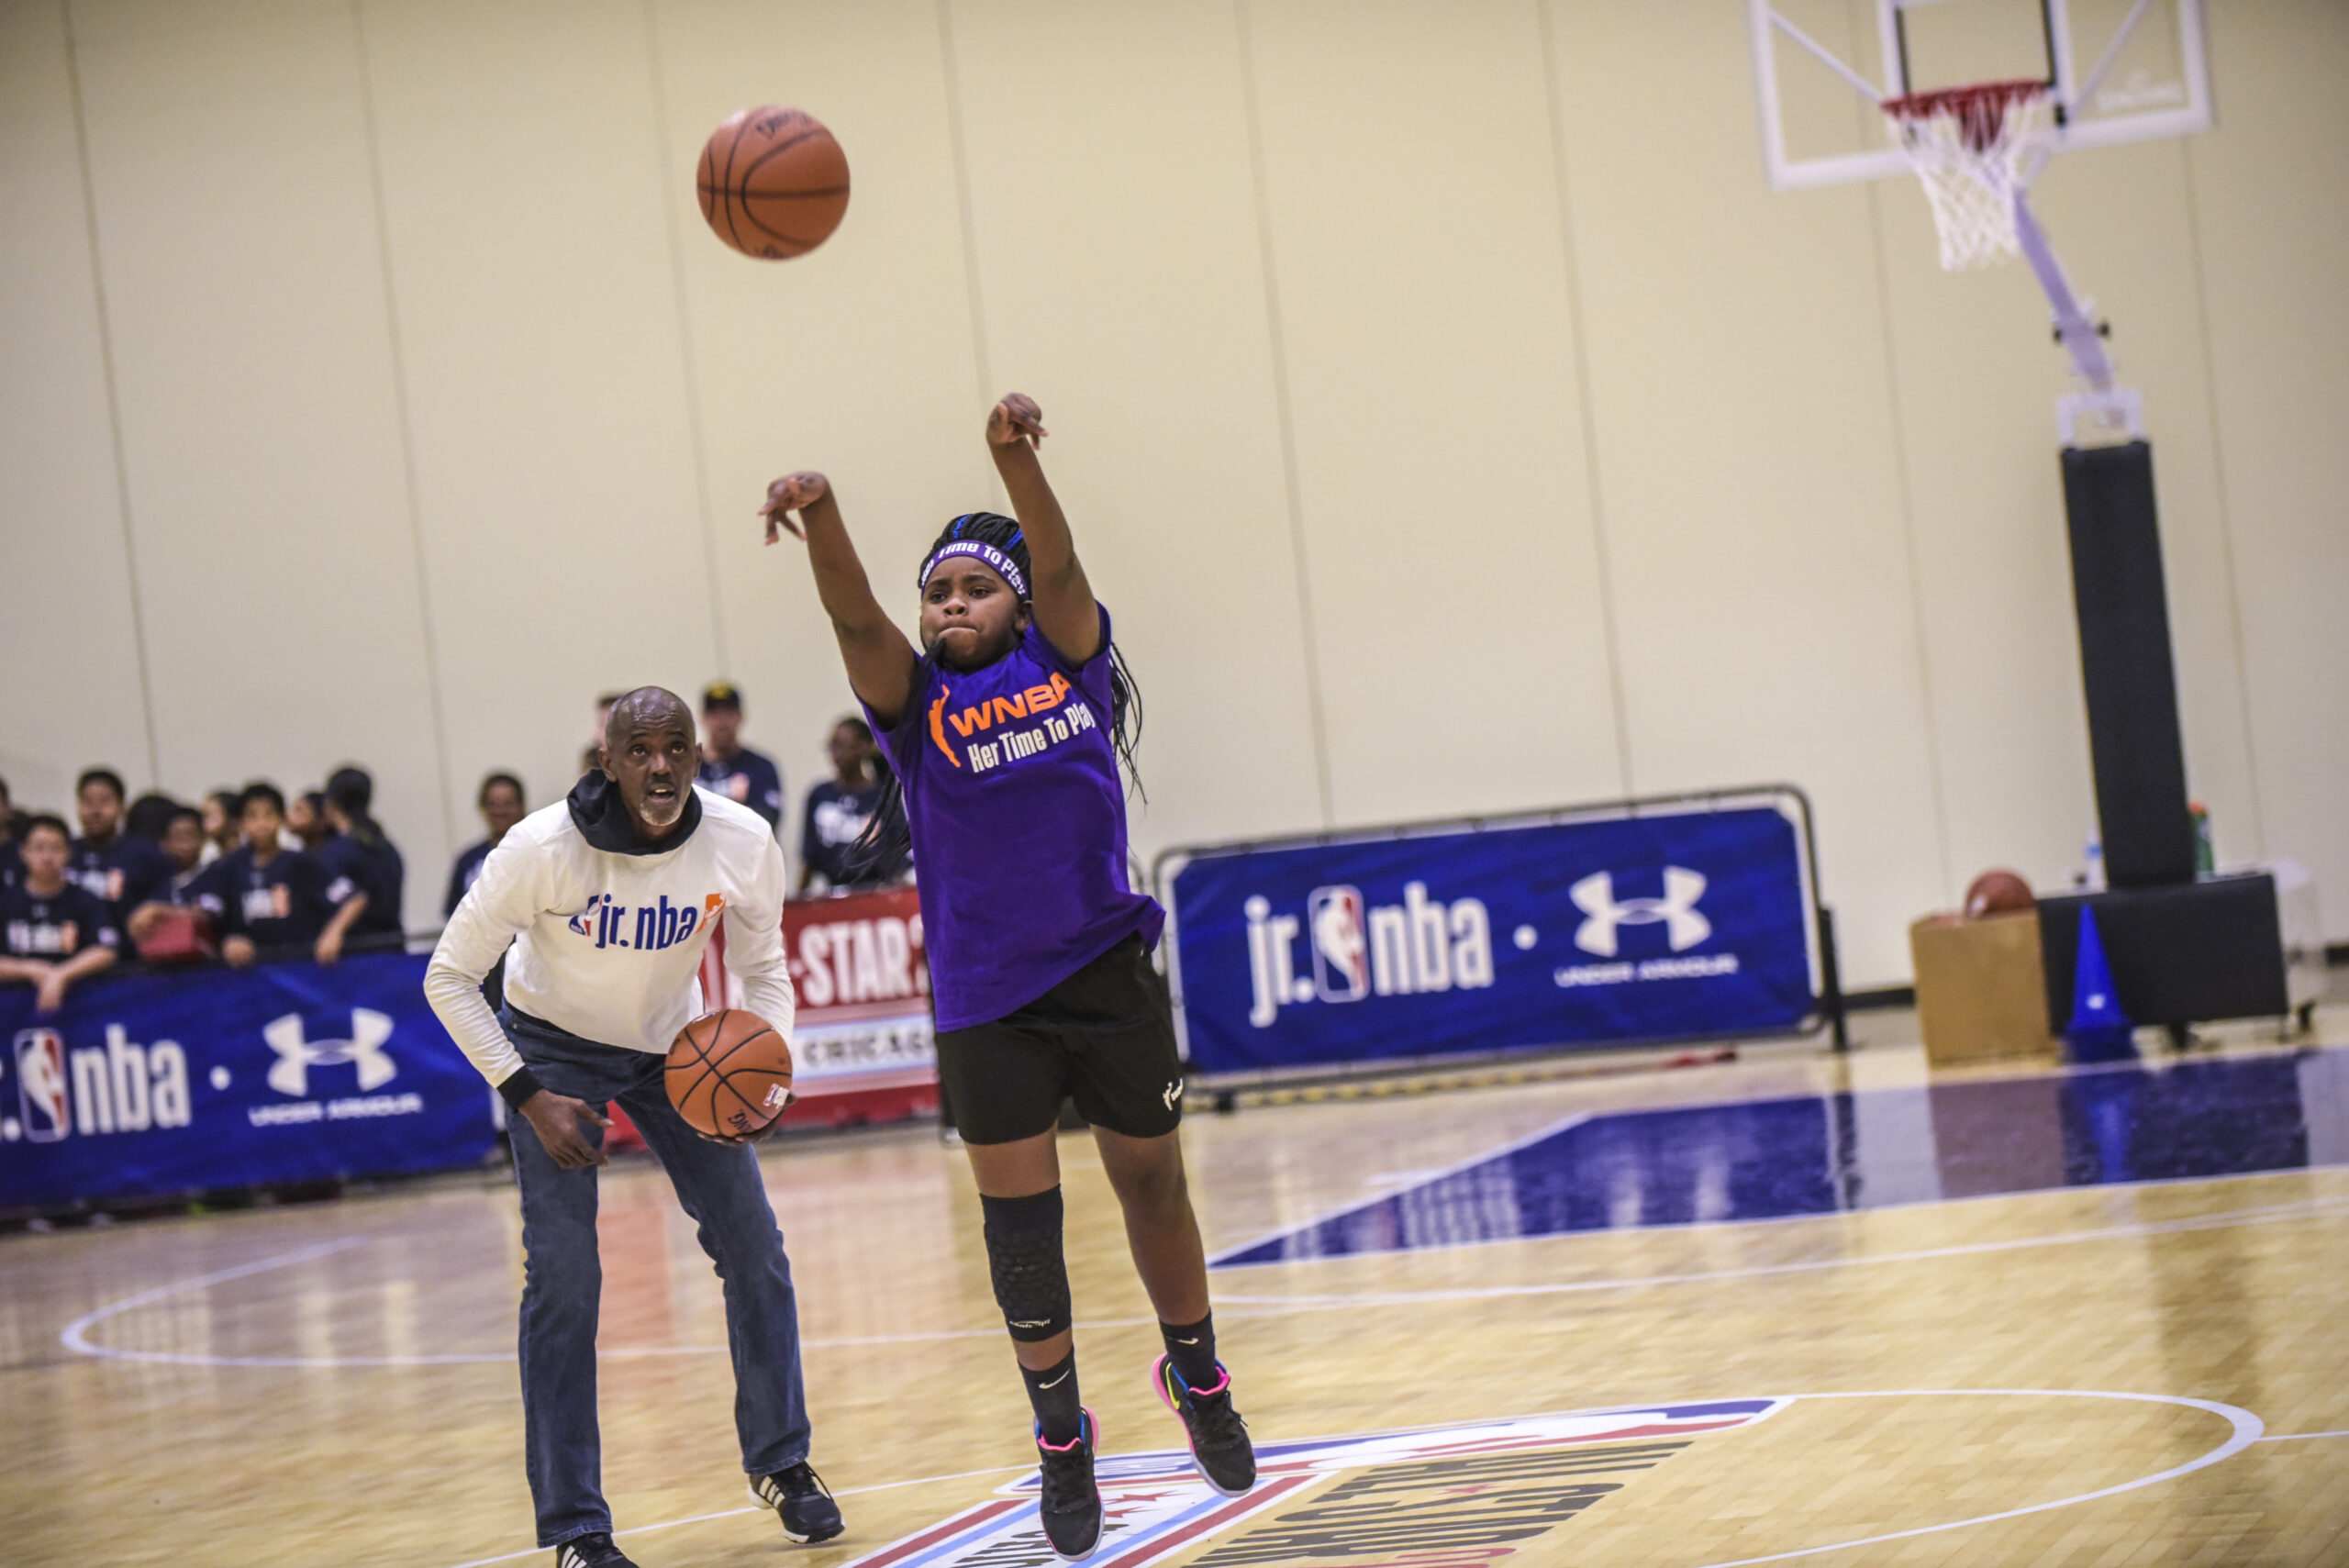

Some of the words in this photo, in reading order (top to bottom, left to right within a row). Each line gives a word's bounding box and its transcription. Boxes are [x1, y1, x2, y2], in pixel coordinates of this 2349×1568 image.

[938, 542, 979, 559] Time
[984, 545, 1002, 565] To
[1000, 558, 1026, 595] Play
[948, 672, 1071, 737] WNBA
[967, 742, 1000, 773] Her
[998, 730, 1048, 762] Time
[1043, 717, 1070, 744] To
[1064, 702, 1097, 735] Play
[595, 893, 629, 949] jr.
[634, 895, 698, 951] nba
[1244, 894, 1316, 1028] jr.
[1368, 879, 1496, 996] nba
[71, 1022, 192, 1136] nba
